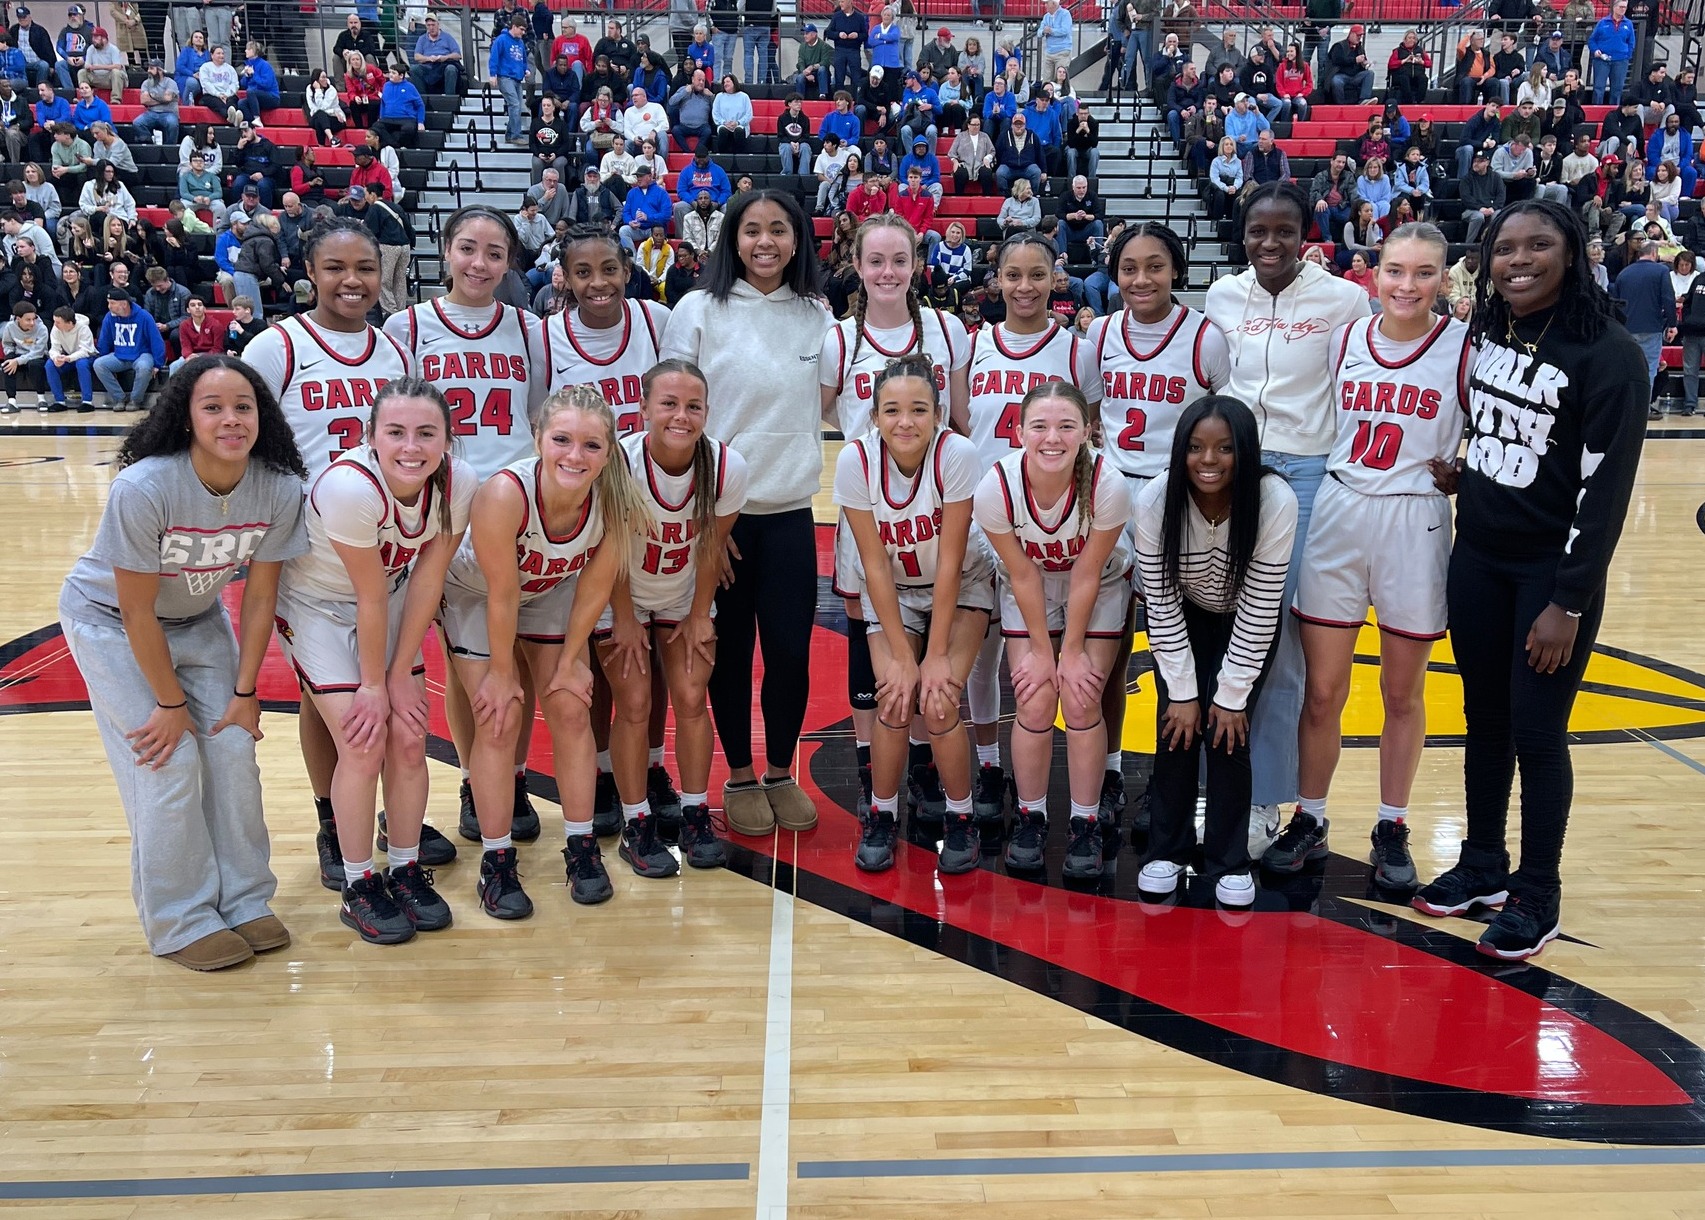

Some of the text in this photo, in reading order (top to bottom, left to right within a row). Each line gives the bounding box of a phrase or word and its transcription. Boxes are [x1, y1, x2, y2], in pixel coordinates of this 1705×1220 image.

[114, 322, 137, 346] KY
[422, 351, 527, 383] CARDS
[1103, 371, 1187, 404] CARDS
[1342, 381, 1442, 420] CARDS
[444, 387, 513, 436] 24
[1117, 407, 1147, 451] 2
[1346, 420, 1404, 471] 10
[641, 542, 690, 575] 13
